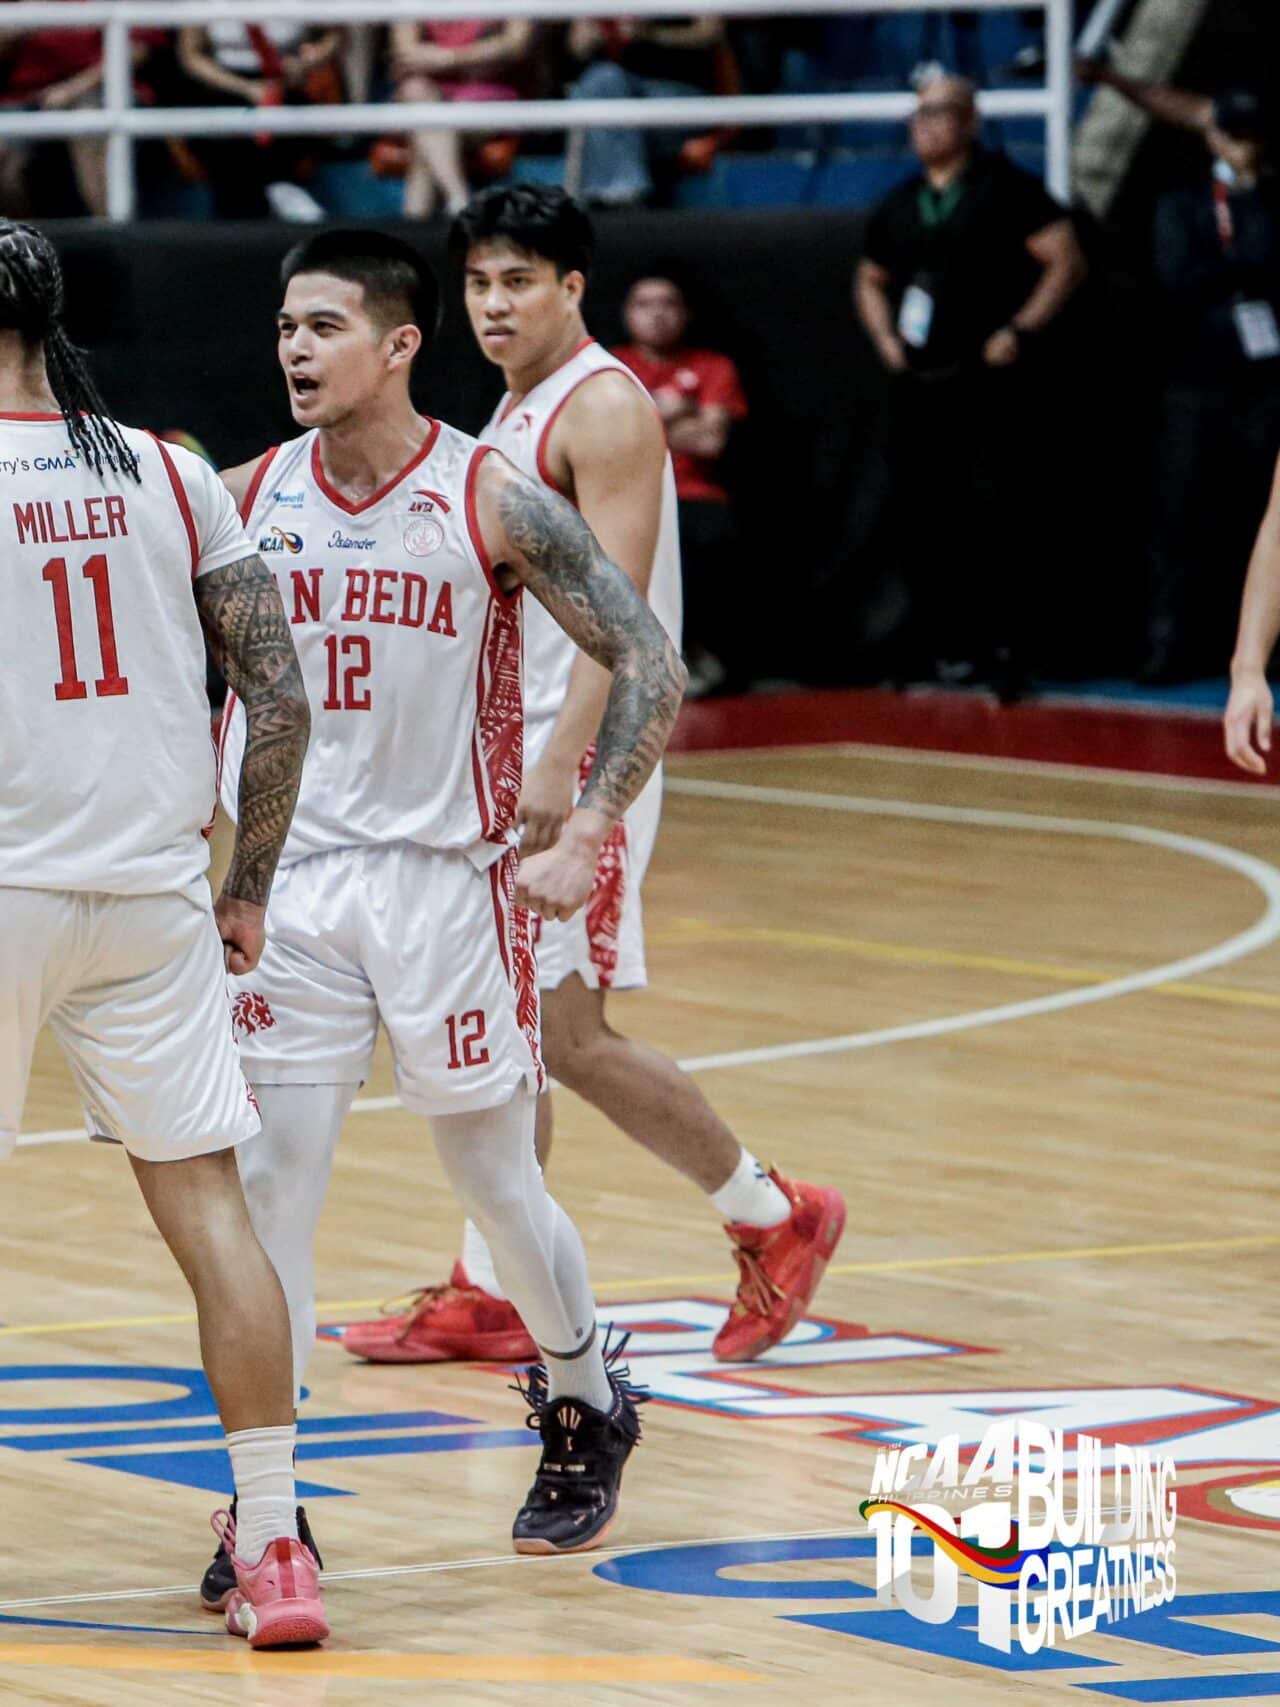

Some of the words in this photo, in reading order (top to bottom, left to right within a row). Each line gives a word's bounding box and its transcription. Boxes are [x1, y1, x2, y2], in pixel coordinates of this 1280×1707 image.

[33, 457, 76, 471] GMA
[13, 495, 129, 544] MILLER
[42, 553, 129, 700] 11
[340, 569, 457, 638] BEDA
[324, 634, 372, 711] 12
[445, 1008, 490, 1070] 12
